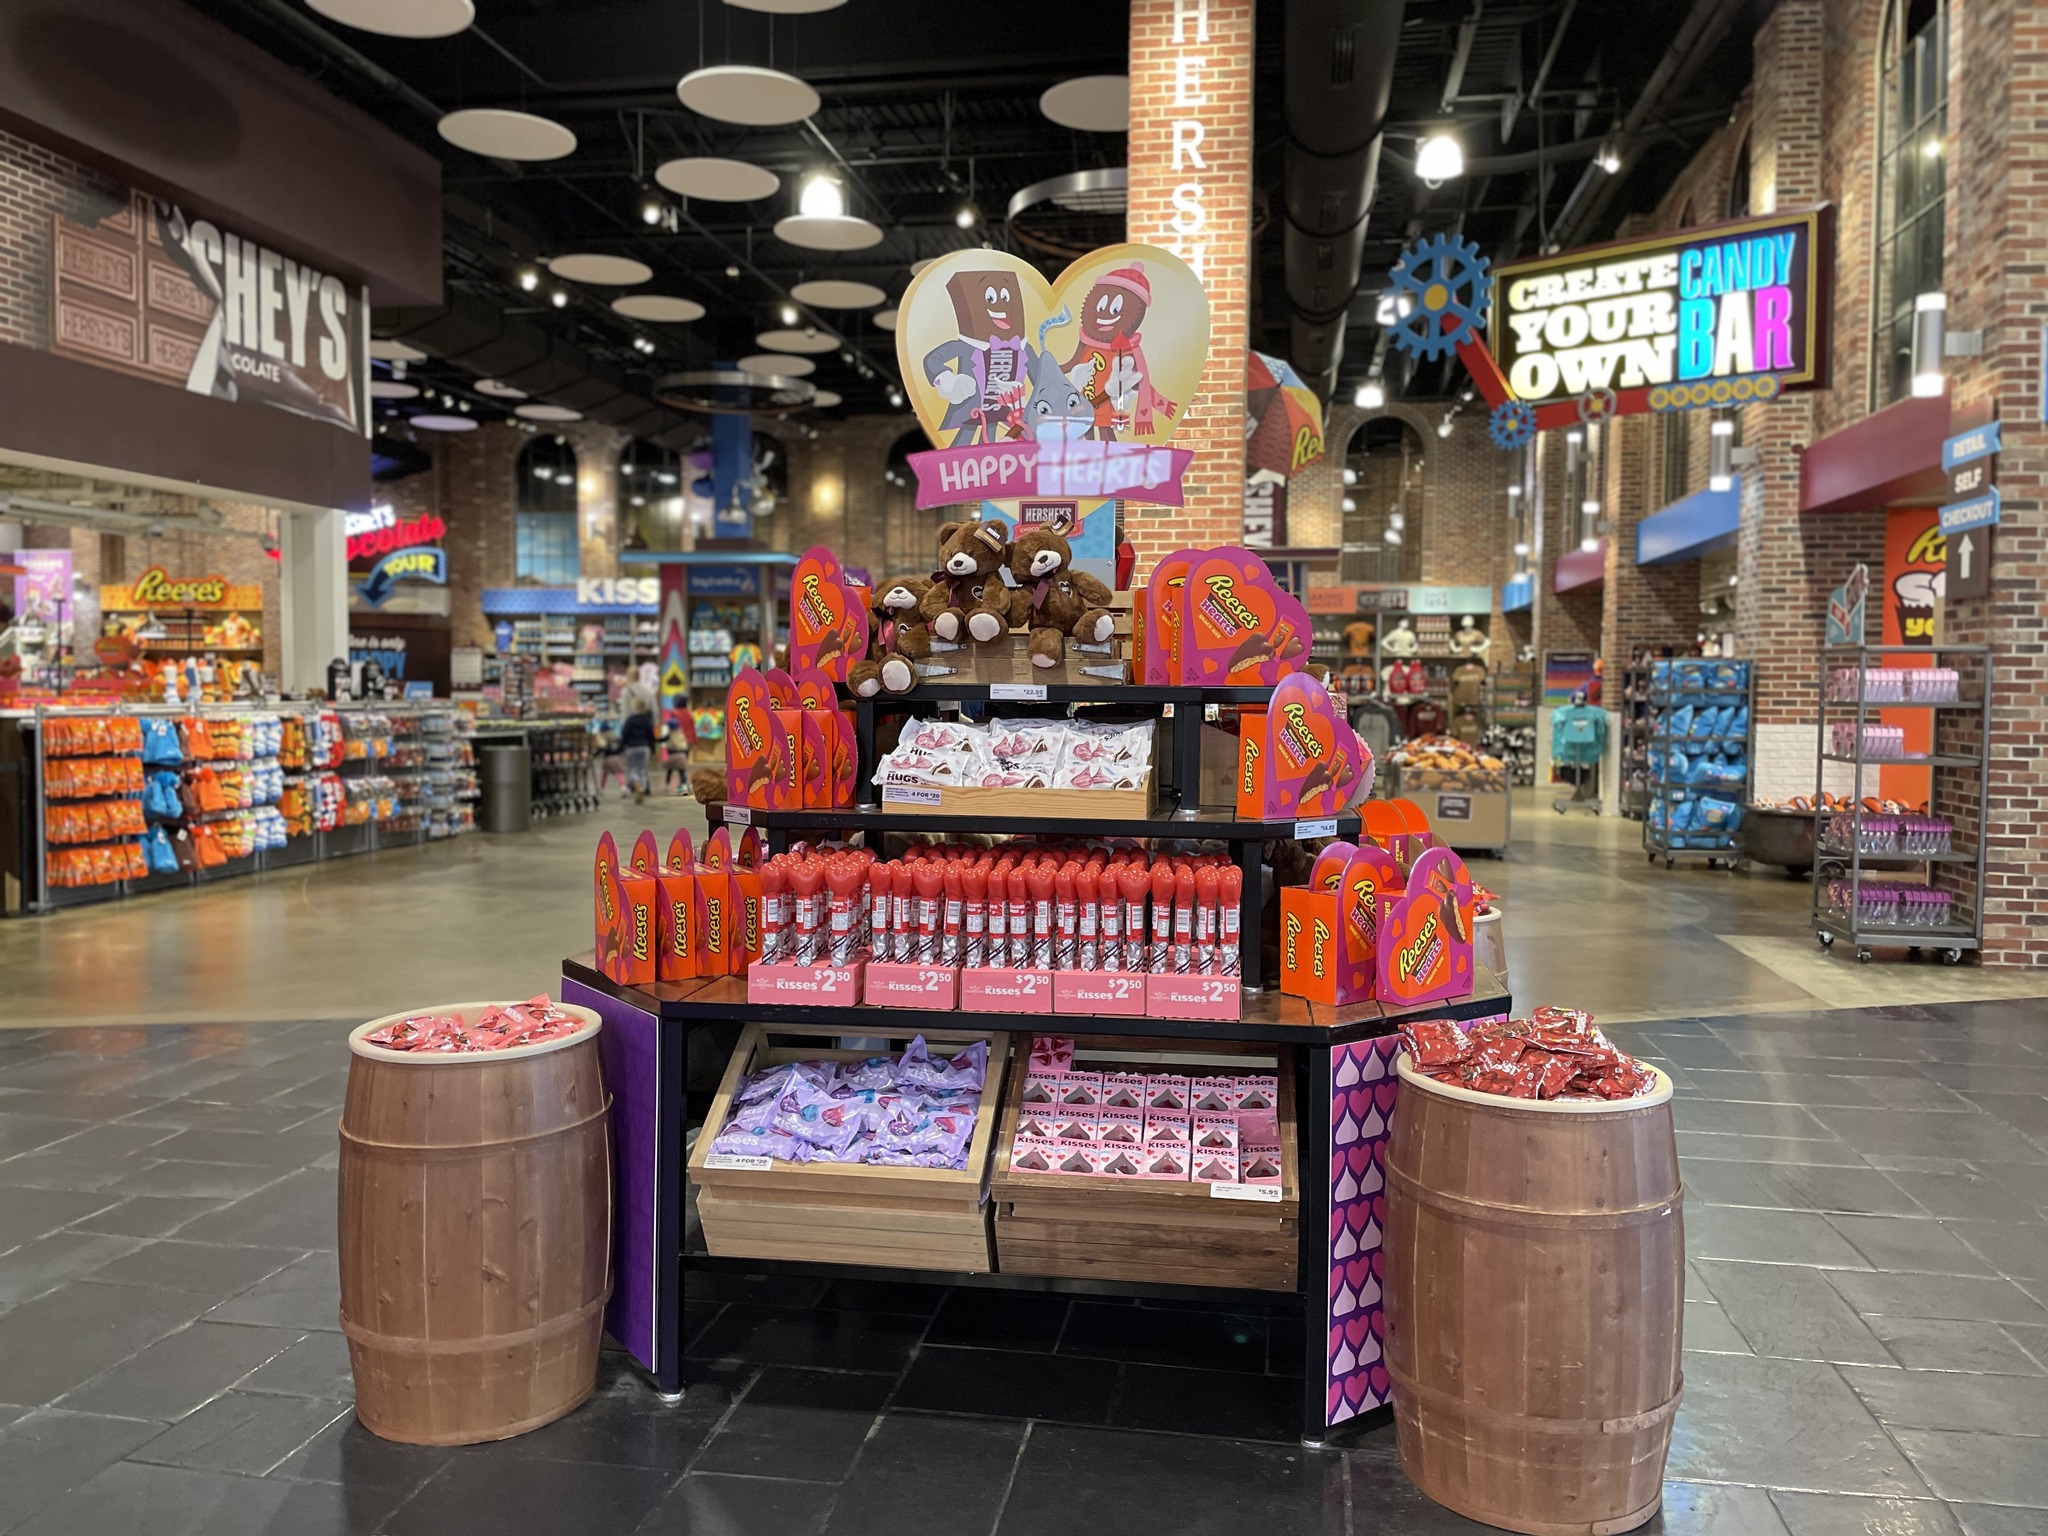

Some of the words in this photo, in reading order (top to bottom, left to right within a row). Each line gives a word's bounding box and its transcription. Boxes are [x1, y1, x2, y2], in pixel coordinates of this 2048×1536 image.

[1508, 252, 1679, 311] CREATE
[1679, 231, 1796, 299] CANDY
[1509, 290, 1678, 354] YOUR
[1678, 285, 1795, 380] BAR
[982, 350, 1014, 412] HERSHEYS
[1509, 334, 1677, 400] OWN
[1952, 433, 1986, 459] RETAIL
[939, 453, 1039, 492] HAPPY
[1051, 452, 1162, 490] HEARTS
[1955, 467, 1983, 493] SELF
[1942, 501, 1995, 528] CHECKOUT
[382, 554, 436, 577] TOUR
[134, 569, 225, 602] Reese's
[577, 577, 660, 605] KISS
[802, 574, 835, 626] Reese's
[1204, 575, 1260, 630] Reese's
[1200, 599, 1237, 637] Hearts
[735, 696, 763, 752] Reese's
[1283, 703, 1324, 758] Reese's
[1279, 727, 1307, 767] Hearts
[887, 773, 919, 784] HUGS
[1244, 737, 1260, 795] Reese's
[633, 903, 648, 961] Reese's
[673, 900, 688, 957] Reese's
[707, 897, 720, 953] Reese's
[744, 896, 757, 952] Reese's
[1287, 911, 1302, 972] Reese's
[1313, 917, 1331, 979] Reese's
[1399, 912, 1439, 983] Reese's
[1415, 937, 1443, 985] Hearts
[776, 980, 818, 991] Kisses
[888, 982, 924, 992] Kisses
[985, 987, 1020, 995] Kisses
[1077, 990, 1114, 1000] Kisses
[1171, 993, 1208, 1003] Kisses
[1064, 1074, 1099, 1082] Kisses
[1107, 1077, 1143, 1085] Kisses
[1195, 1080, 1231, 1088] Kisses
[1058, 1110, 1095, 1118] Kisses
[1102, 1112, 1139, 1120] Kisses
[1149, 1115, 1186, 1123] Kisses
[715, 1136, 759, 1146] Kisses
[1017, 1137, 1055, 1146] Kisses
[1060, 1140, 1098, 1149] Kisses
[1104, 1142, 1142, 1151] Kisses
[1196, 1149, 1235, 1157] Kisses
